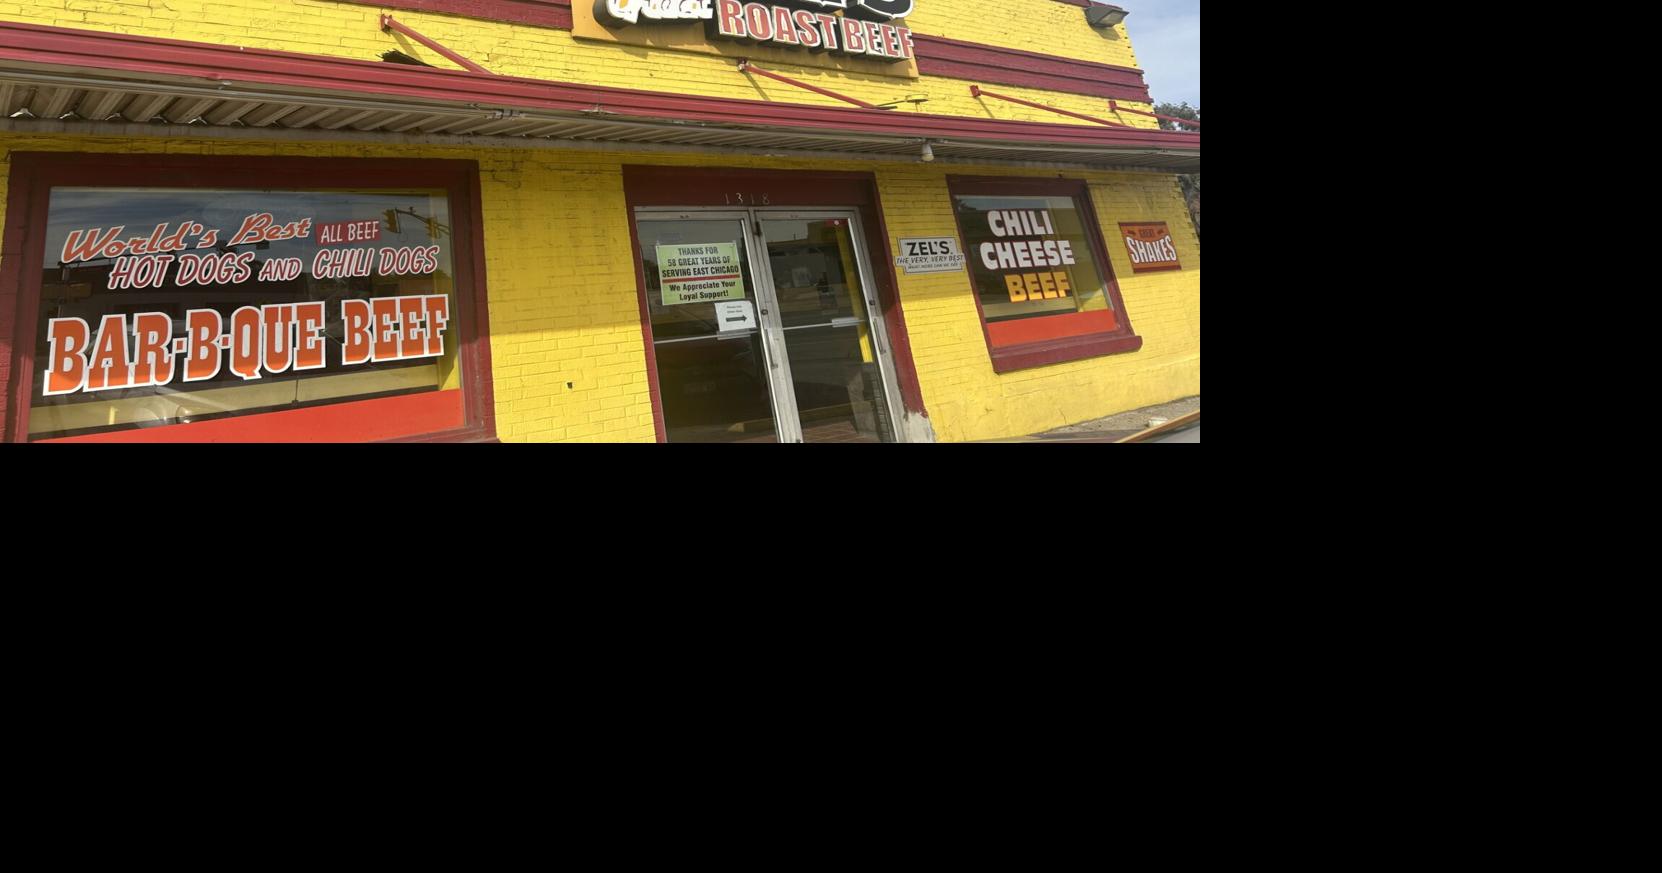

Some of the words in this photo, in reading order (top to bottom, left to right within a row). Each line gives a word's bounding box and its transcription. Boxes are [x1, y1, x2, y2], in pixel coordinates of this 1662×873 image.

[717, 0, 838, 49] ROAST
[839, 16, 914, 58] BEEF
[725, 192, 770, 205] 1318
[320, 225, 343, 244] ALL
[347, 221, 380, 241] BEEF
[987, 210, 1054, 237] CHILI
[61, 220, 220, 264] World's
[226, 212, 312, 246] Best
[1126, 235, 1177, 263] SHAKES
[667, 258, 677, 267] 58
[678, 257, 699, 266] GREAT
[700, 256, 722, 265] YEARS
[722, 255, 731, 264] OF
[677, 247, 704, 256] THANKS
[705, 246, 719, 255] FOR
[896, 257, 909, 265] THE
[948, 254, 964, 262] BEST
[980, 240, 1075, 270] CHEESE
[107, 255, 173, 290] HOT
[175, 251, 255, 287] DOGS
[258, 257, 303, 282] AND
[312, 247, 375, 280] CHILI
[378, 244, 440, 276] DOGS
[662, 268, 692, 278] SERVING
[692, 267, 709, 276] EAST
[710, 265, 739, 275] CHICAGO
[679, 293, 698, 302] Loyal
[699, 290, 729, 299] Support!
[682, 282, 720, 292] Appreciate
[1004, 271, 1071, 302] BEEF
[341, 293, 449, 365] BEEF
